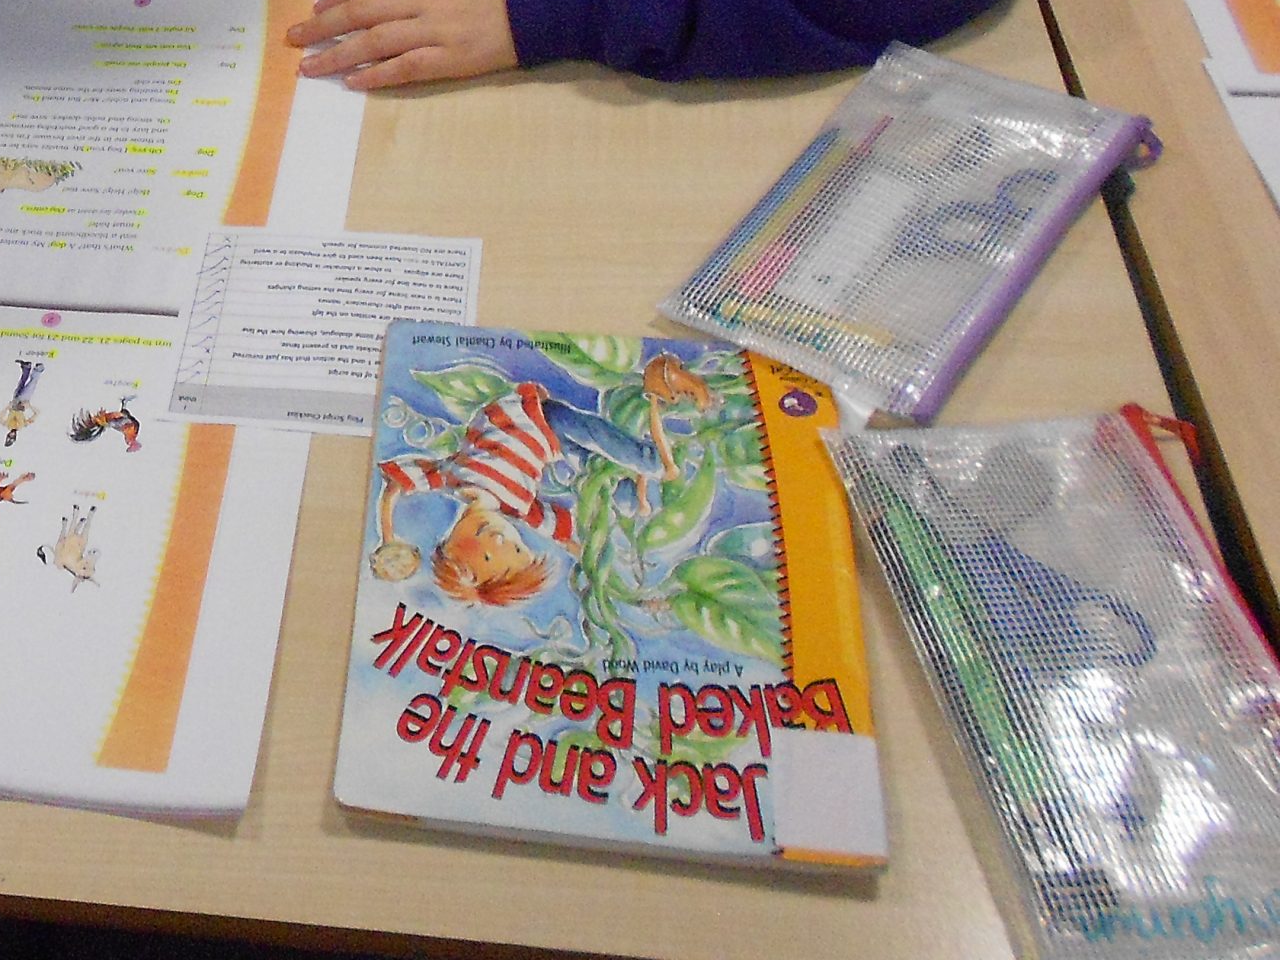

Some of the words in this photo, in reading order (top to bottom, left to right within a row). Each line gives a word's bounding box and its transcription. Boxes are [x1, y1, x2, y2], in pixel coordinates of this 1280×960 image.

[32, 239, 46, 248] My
[312, 309, 324, 317] left
[437, 307, 461, 315] Colons
[302, 340, 329, 349] present
[412, 336, 451, 347] Stewart
[455, 336, 495, 349] Chantal
[500, 337, 512, 350] by
[517, 339, 571, 354] Illustrated
[266, 352, 280, 360] just
[364, 371, 372, 379] of
[287, 411, 320, 420] Checklist
[323, 413, 345, 422] Script
[347, 414, 364, 423] Play
[603, 659, 639, 673] Wood
[643, 660, 679, 675] David
[684, 660, 698, 675] by
[704, 660, 730, 676] play
[734, 664, 744, 678] A
[371, 602, 637, 750] Beanstalk
[657, 679, 853, 757] Baked
[395, 693, 492, 784] the
[492, 728, 616, 806] and
[632, 757, 769, 844] Jack
